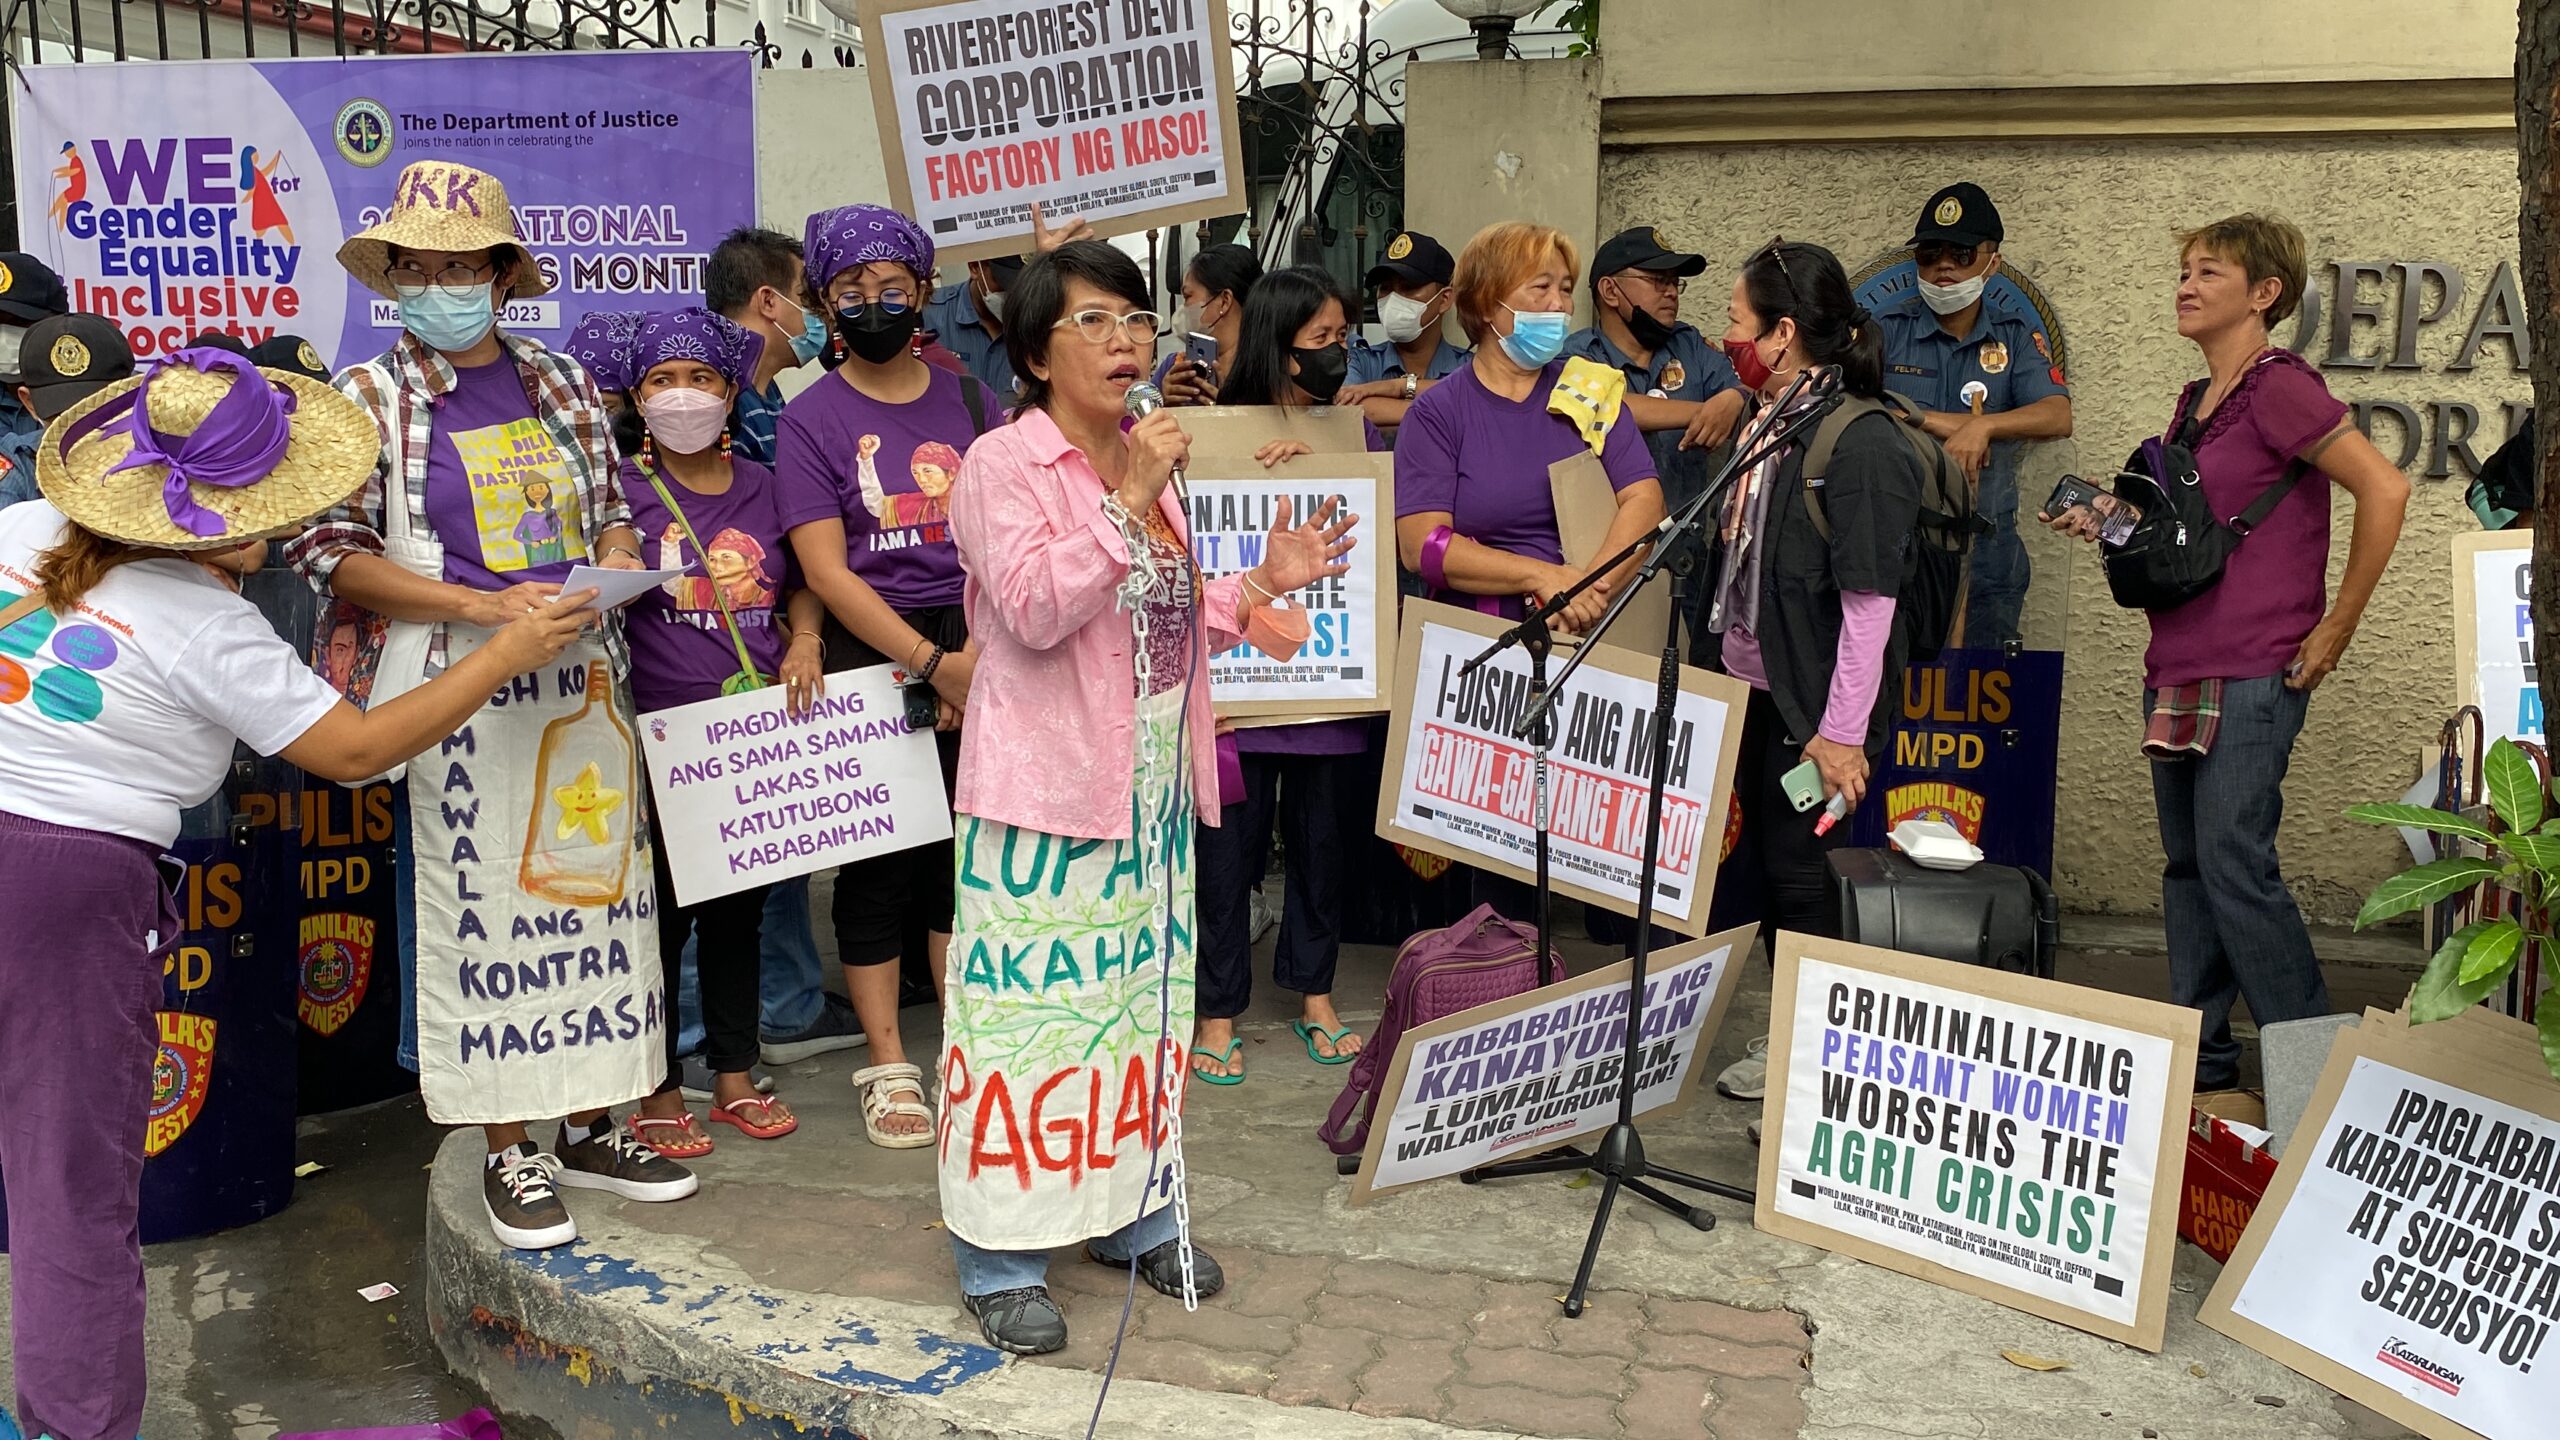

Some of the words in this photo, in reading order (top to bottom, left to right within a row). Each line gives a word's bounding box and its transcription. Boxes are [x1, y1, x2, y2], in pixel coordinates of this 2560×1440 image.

[904, 0, 1111, 75] RIVERFOREST
[916, 40, 1204, 146] CORPORATION
[400, 113, 437, 132] The
[443, 112, 570, 134] Department
[575, 110, 597, 129] of
[601, 110, 679, 129] Justice
[403, 135, 431, 149] joins
[433, 135, 452, 148] the
[454, 135, 491, 148] nation
[493, 134, 505, 147] in
[507, 133, 573, 150] celebrating
[574, 133, 594, 146] the
[91, 137, 237, 205] WE
[270, 176, 300, 194] for
[925, 136, 1060, 201] FACTORY
[1072, 127, 1114, 177] NG
[1121, 109, 1209, 167] KASO!
[66, 198, 237, 239] Gender
[511, 206, 686, 245] ATIONAL
[957, 212, 979, 223] WORLD
[979, 208, 1001, 219] MARCH
[1091, 189, 1109, 199] FOCUS
[1110, 186, 1118, 195] ON
[1119, 185, 1129, 194] THE
[1129, 180, 1149, 191] GLOBAL
[100, 236, 301, 286] Equality
[75, 277, 299, 317] Inclusive
[499, 306, 541, 323] 2023
[498, 450, 560, 469] MABAS
[512, 433, 547, 453] DILI
[870, 533, 875, 551] I
[878, 530, 907, 551] AM
[910, 529, 922, 546] A
[924, 525, 954, 544] RES
[662, 609, 672, 624] I
[674, 611, 702, 630] AM
[705, 612, 719, 630] A
[557, 664, 586, 698] KO
[1234, 666, 1252, 675] FOCUS
[1252, 666, 1261, 674] ON
[1262, 666, 1272, 674] THE
[1273, 665, 1293, 674] GLOBAL
[1904, 667, 2012, 723] ULIS
[1563, 691, 1624, 771] ANG
[1896, 731, 1985, 769] MPD
[669, 757, 724, 789] ANG
[728, 739, 802, 774] SAMA
[735, 767, 820, 806] LAKAS
[824, 757, 863, 785] NG
[239, 785, 394, 848] PULIS
[719, 782, 891, 843] KATUTUBONG
[1886, 782, 1986, 823] MANILA'S
[729, 814, 896, 875] KABABAIHAN
[1402, 845, 1453, 880] FINES
[1581, 856, 1592, 867] THE
[299, 913, 375, 948] ANILA'S
[511, 908, 584, 941] ANG
[458, 938, 631, 1000] KONTRA
[1665, 962, 1713, 1002] NG
[298, 992, 356, 1035] FINEST
[1826, 982, 2135, 1099] CRIMINALIZING
[1821, 1028, 1977, 1103] PEASANT
[1992, 1068, 2129, 1146] WOMEN
[1397, 1113, 1517, 1162] WALANG
[1820, 1070, 2019, 1169] WORSENS
[2041, 1130, 2121, 1199] THE
[1806, 1120, 1916, 1201] AGRI
[1936, 1157, 2117, 1262] CRISIS!
[2326, 1124, 2530, 1241] KARAPATAN
[1818, 1185, 1839, 1199] WORLD
[1840, 1191, 1864, 1206] MARCH
[1865, 1198, 1874, 1209] OF
[1875, 1201, 1901, 1219] WOMEN,
[1902, 1210, 1921, 1225] PKKK,
[1922, 1216, 1964, 1240] KATARUNGAN,
[1965, 1230, 1987, 1246] FOCUS
[1988, 1237, 1998, 1250] ON
[1999, 1240, 2011, 1253] THE
[2012, 1244, 2037, 1262] GLOBAL
[2039, 1253, 2062, 1270] SOUTH,
[2064, 1262, 2094, 1280] IDEFEND,
[1833, 1201, 1853, 1215] LILAK,
[1854, 1206, 1879, 1223] SENTRO,
[1881, 1214, 1897, 1229] WLB,
[1898, 1220, 1926, 1238] CATWAP,
[1927, 1229, 1943, 1244] CMA,
[1945, 1235, 1977, 1255] SARILAYA,
[1979, 1246, 2032, 1272] WOMANHEALTH,
[2033, 1262, 2053, 1279] LILAK,
[2055, 1269, 2073, 1284] SARA
[2193, 1215, 2243, 1255] COP
[2346, 1190, 2401, 1246] AT
[2398, 1211, 2560, 1323] SUPORTA
[2360, 1254, 2551, 1375] SERBISYO!
[2382, 1336, 2465, 1386] KATARUNGAN
